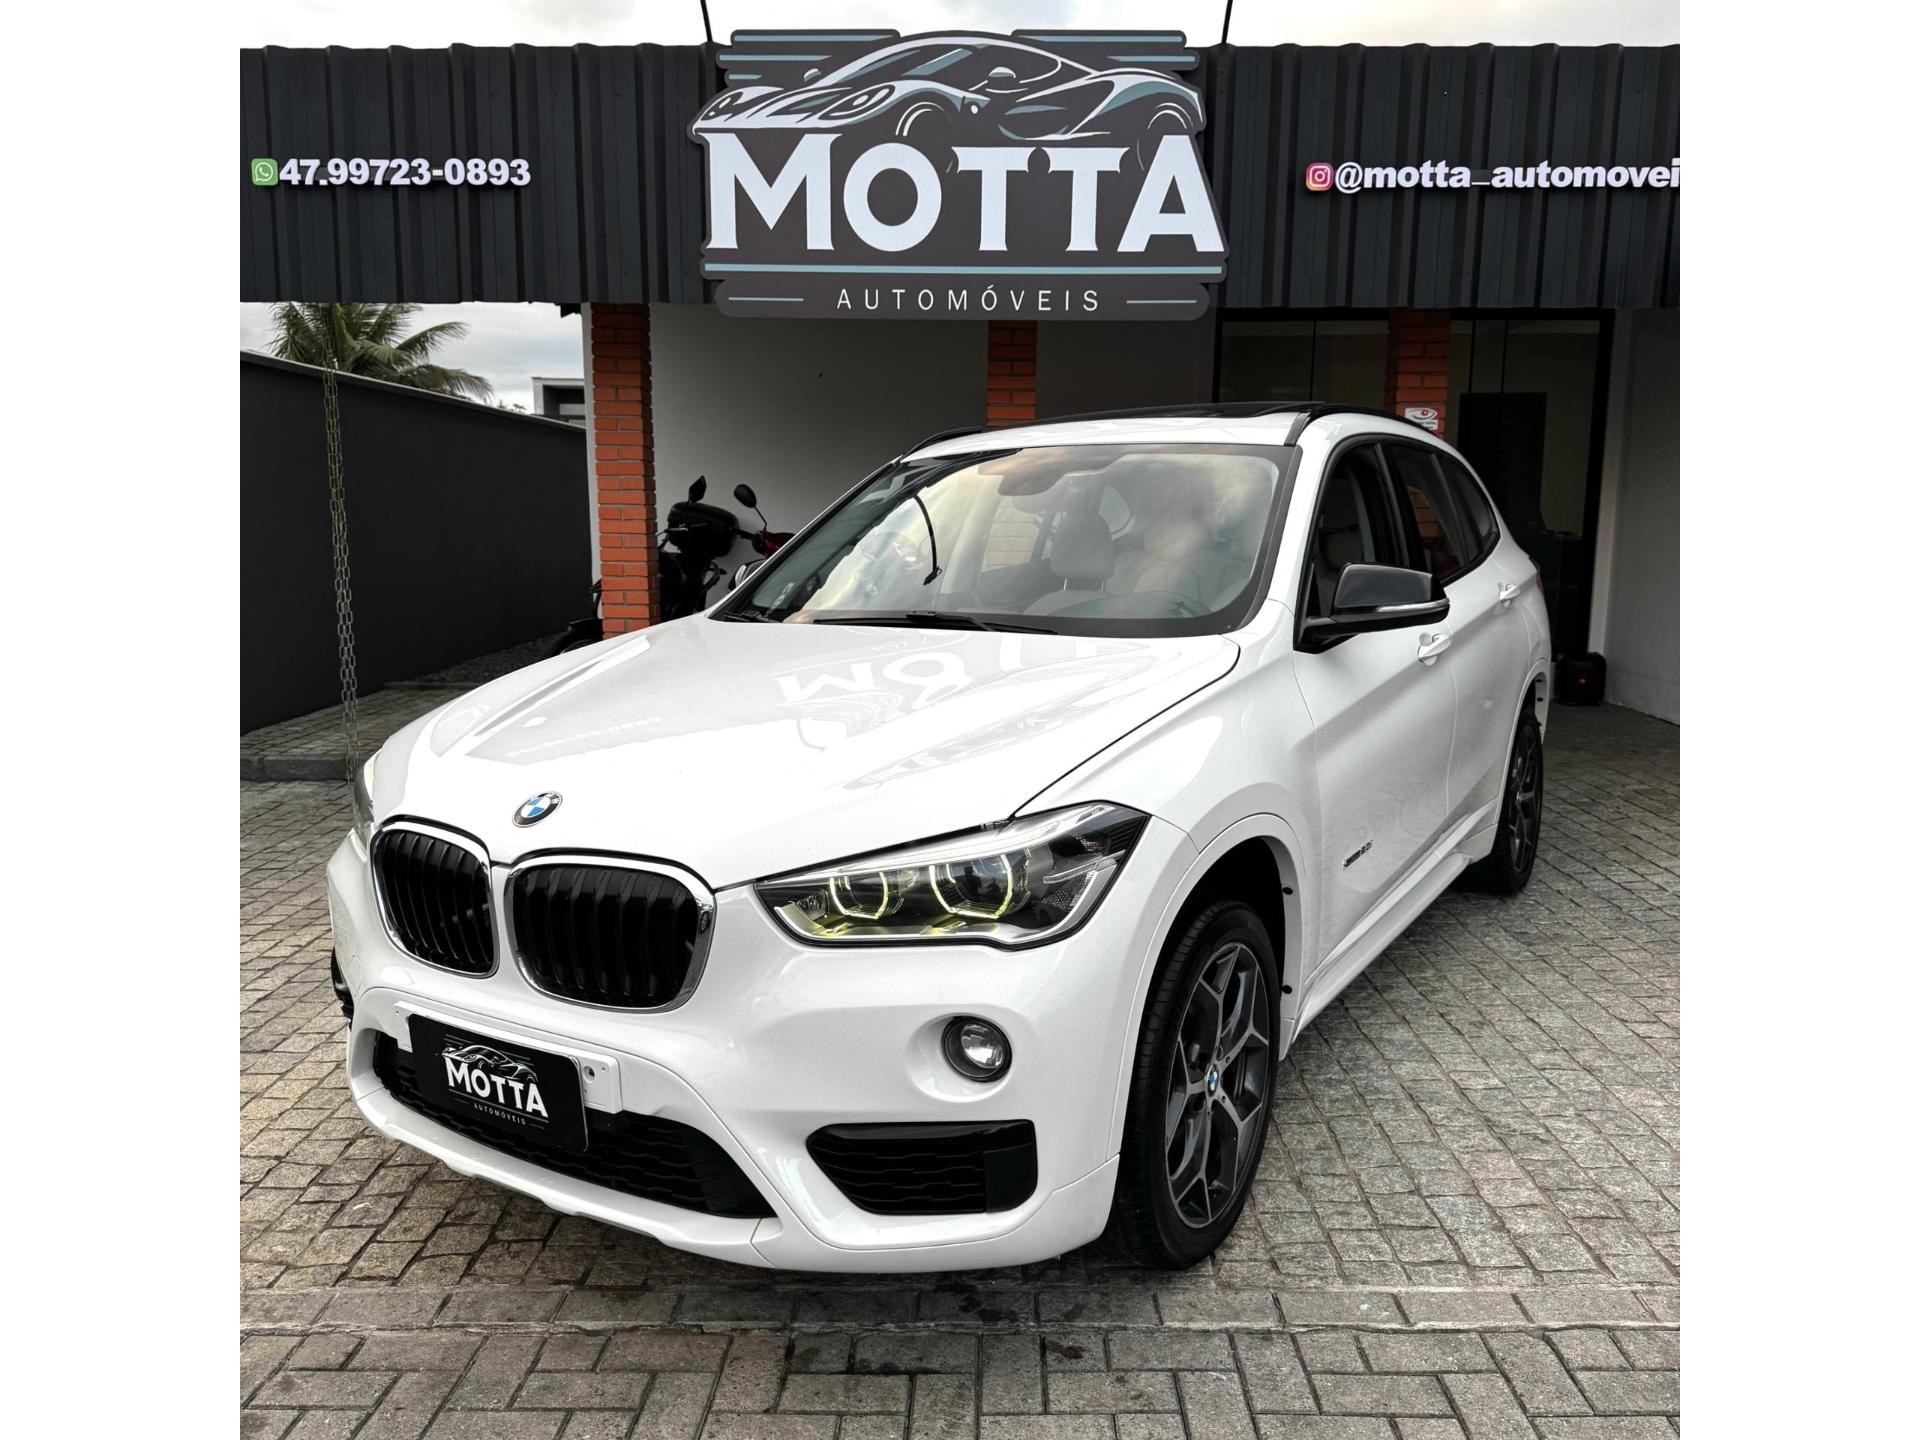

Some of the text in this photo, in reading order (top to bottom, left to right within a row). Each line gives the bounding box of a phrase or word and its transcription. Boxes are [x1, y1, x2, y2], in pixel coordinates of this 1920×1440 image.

[279, 158, 531, 185] 47.99723-0893
[699, 132, 1225, 252] MOTTA
[837, 285, 1099, 312] AUTOMÓVEIS
[444, 1057, 549, 1117] MOTTA
